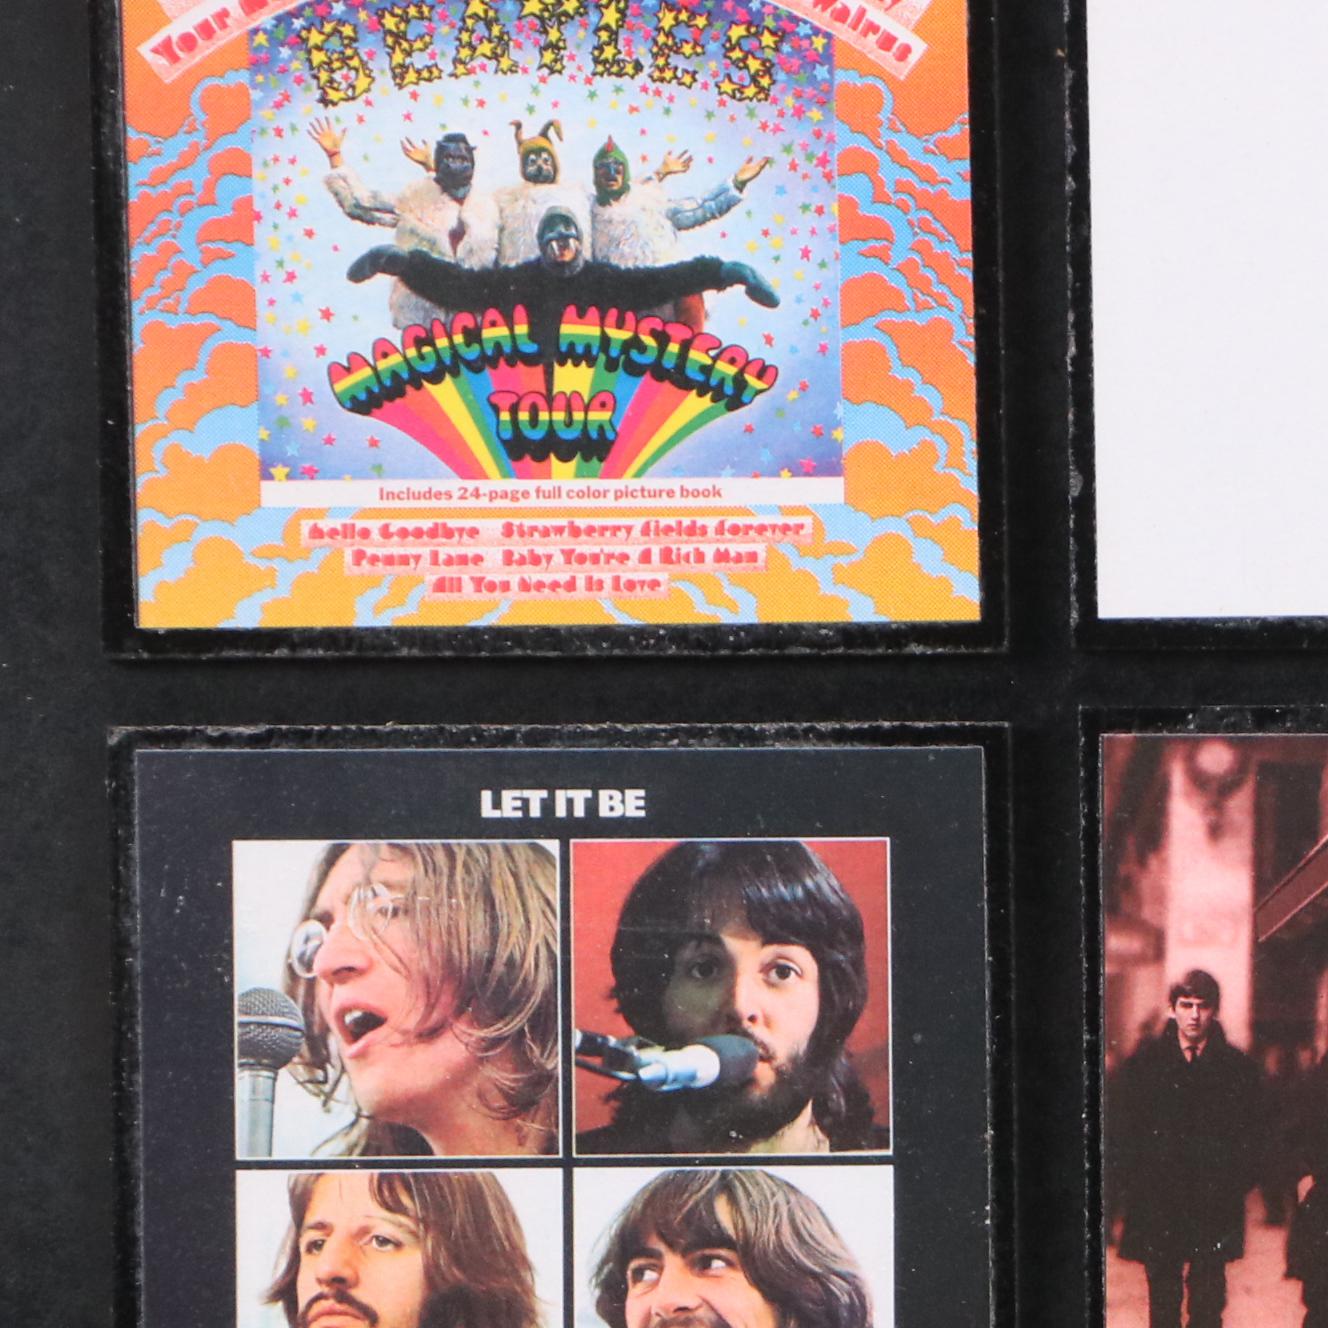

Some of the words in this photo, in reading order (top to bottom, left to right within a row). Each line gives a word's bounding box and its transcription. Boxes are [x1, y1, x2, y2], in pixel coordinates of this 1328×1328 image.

[150, 7, 230, 65] Your
[327, 303, 540, 413] MAGICAL
[554, 303, 779, 413] MYSTERY
[487, 390, 618, 463] TOUR
[379, 486, 453, 501] Includes
[457, 485, 530, 502] 24-page
[534, 486, 562, 500] full
[566, 486, 610, 500] color
[614, 485, 676, 501] picture
[680, 484, 722, 499] book
[480, 788, 548, 818] LET
[555, 788, 592, 818] IT
[598, 788, 646, 818] BE
